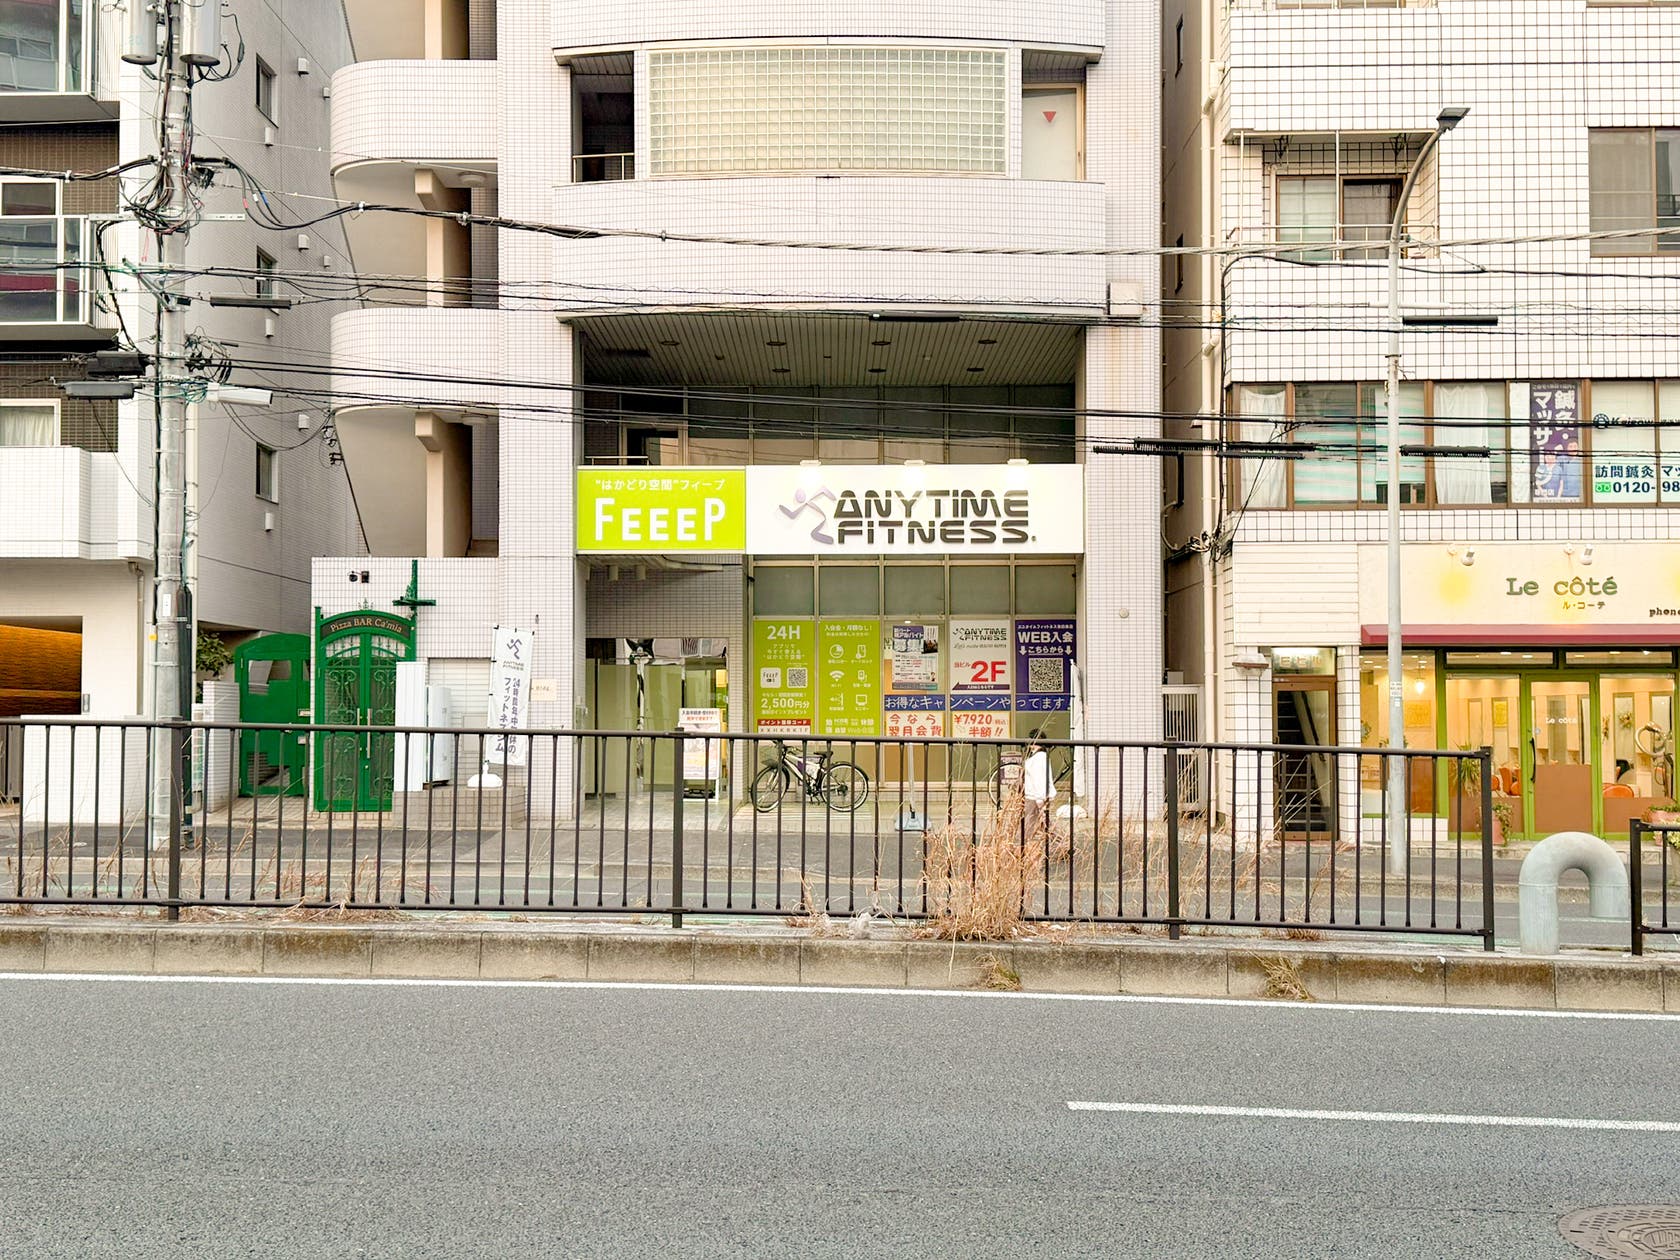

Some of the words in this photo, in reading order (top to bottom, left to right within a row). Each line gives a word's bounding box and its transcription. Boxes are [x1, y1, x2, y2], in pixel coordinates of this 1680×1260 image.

[834, 489, 1029, 518] ANYTIME
[1506, 577, 1540, 596] Le
[1553, 576, 1618, 596] côté
[330, 621, 352, 632] Pizza
[353, 618, 373, 627] BAR
[767, 625, 801, 640] 24H
[1018, 631, 1073, 643] WEB入会
[1028, 646, 1063, 654] こちらから
[971, 661, 1006, 682] 2F
